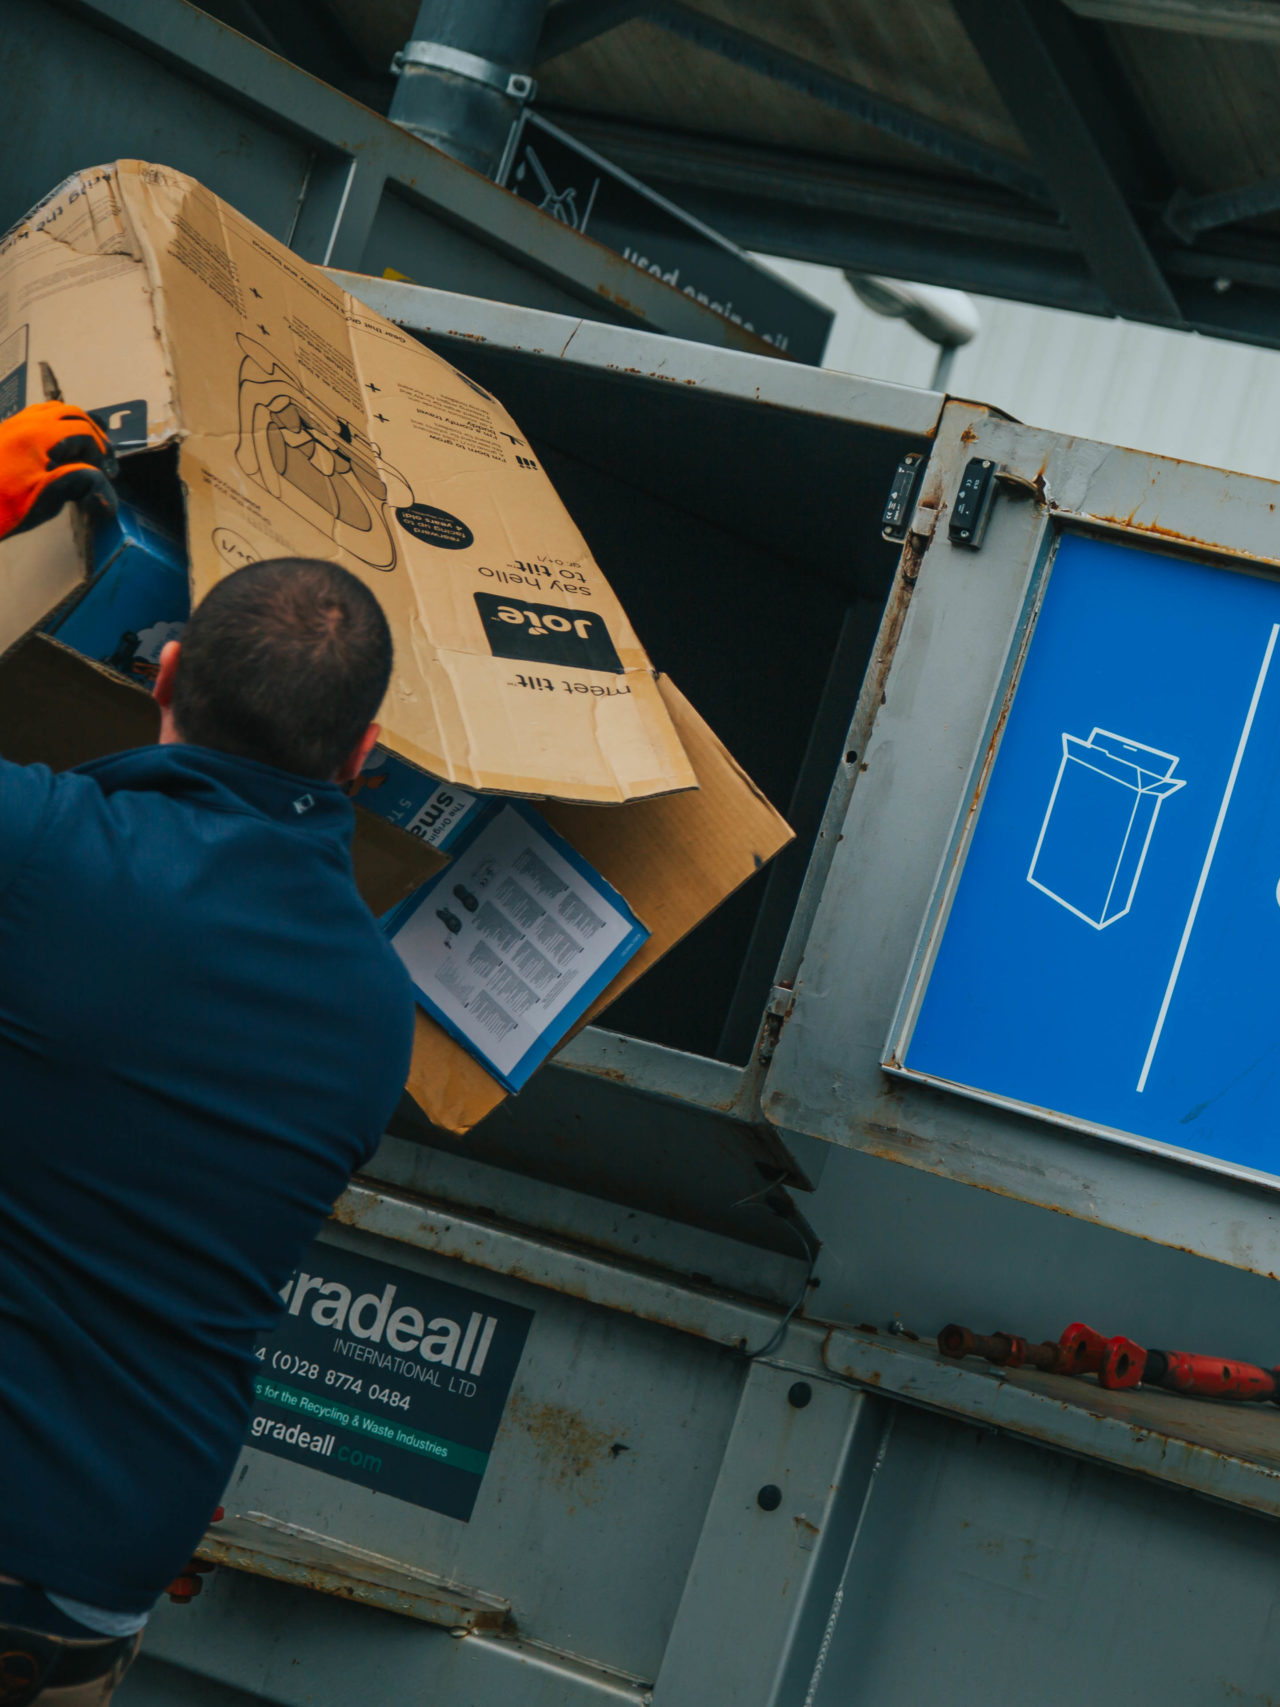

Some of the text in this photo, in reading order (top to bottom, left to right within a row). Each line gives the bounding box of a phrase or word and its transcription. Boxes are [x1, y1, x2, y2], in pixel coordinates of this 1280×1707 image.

[402, 518, 467, 540] facing up to
[413, 527, 460, 543] rearward
[425, 518, 454, 529] years
[478, 567, 592, 597] say hello
[559, 569, 587, 584] to
[562, 680, 632, 697] meet
[410, 792, 454, 838] sma
[428, 803, 466, 842] The Origin
[278, 1270, 498, 1377] radeall
[253, 1345, 411, 1411] 4 (0)28 8774 0484
[333, 1338, 477, 1398] INTERNATIONAL LTD
[264, 1383, 280, 1400] for
[281, 1388, 298, 1406] the
[300, 1397, 351, 1426] Recycling
[352, 1414, 360, 1427] &
[362, 1418, 395, 1439] Waste
[396, 1430, 449, 1458] Industries
[251, 1415, 384, 1475] gradeall.com
